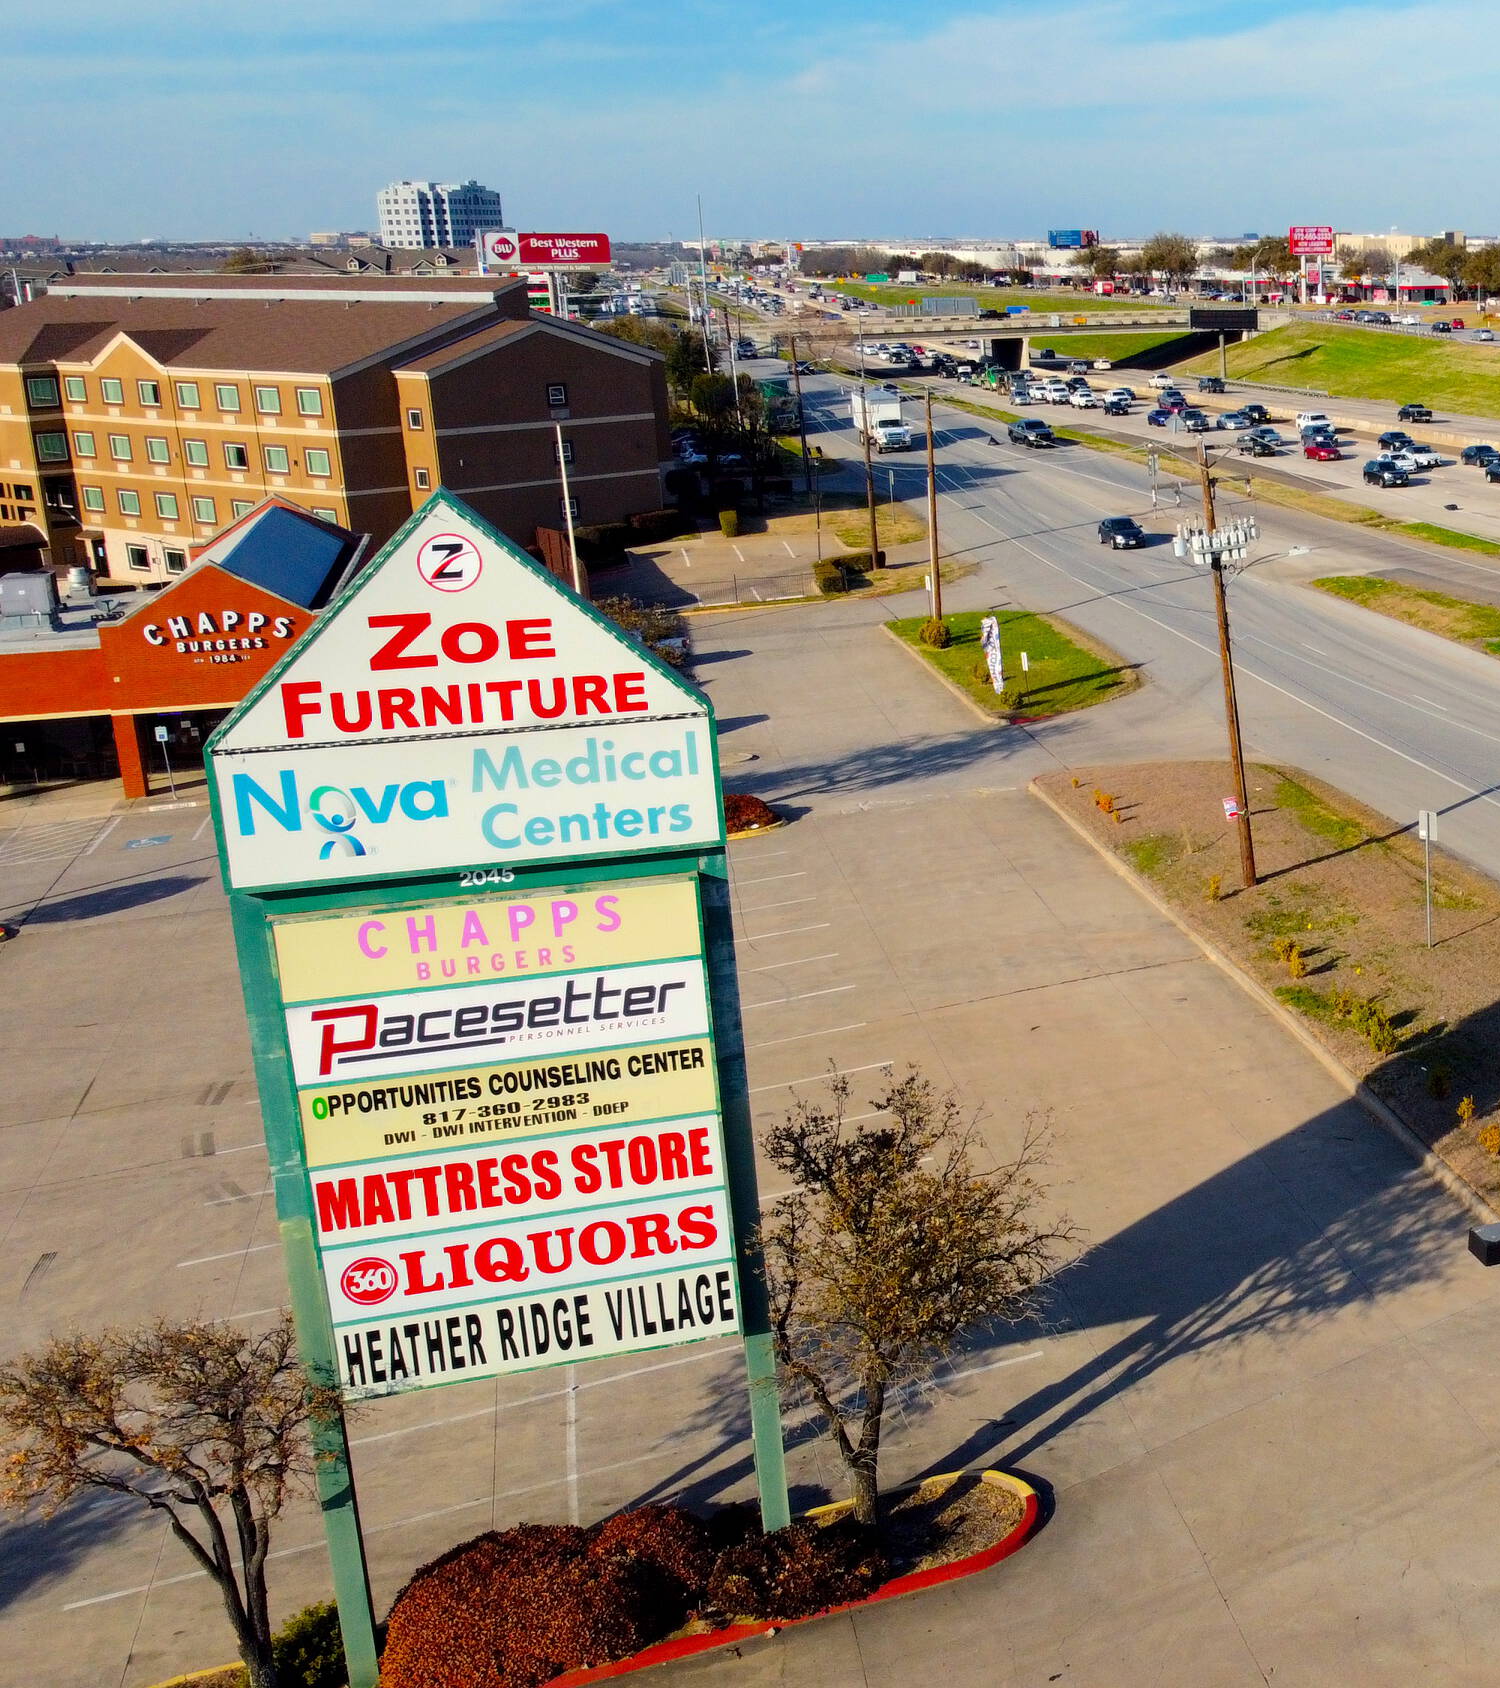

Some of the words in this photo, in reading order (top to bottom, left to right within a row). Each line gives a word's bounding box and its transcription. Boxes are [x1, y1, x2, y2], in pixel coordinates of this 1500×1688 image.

[494, 243, 513, 254] BW
[530, 238, 553, 248] Best
[555, 238, 599, 248] Western
[551, 248, 580, 258] PLUS
[143, 611, 291, 646] CHAPPS
[176, 637, 264, 653] BURGERS
[368, 613, 556, 671] ZOE
[209, 654, 236, 664] 1984
[281, 672, 649, 739] FURNITURE
[471, 731, 699, 793] Medical
[232, 770, 450, 850] Nova
[481, 801, 693, 849] Centers
[459, 868, 515, 888] 2045
[357, 895, 623, 960] CHAPPS
[416, 945, 577, 981] BURGERS
[311, 976, 687, 1077] Pacesetter
[509, 1025, 592, 1043] PERSONNEL
[600, 1016, 666, 1032] SERVICES
[312, 1077, 482, 1121] OPPORTUNITIES
[488, 1059, 622, 1097] COUNSELING
[627, 1048, 705, 1077] CENTER
[384, 1131, 417, 1146] DWI
[432, 1124, 465, 1140] DWI
[469, 1110, 579, 1134] INTERVENTION
[592, 1101, 630, 1118] DOEP
[423, 1092, 591, 1126] 817-360-2983
[315, 1148, 563, 1233] MATTRESS
[570, 1127, 714, 1217] STORE
[349, 1266, 394, 1295] 360
[399, 1204, 719, 1298] LIQUORS
[343, 1313, 489, 1388] HEATHER
[499, 1294, 594, 1361] RIDGE
[604, 1270, 736, 1342] VILLAGE
